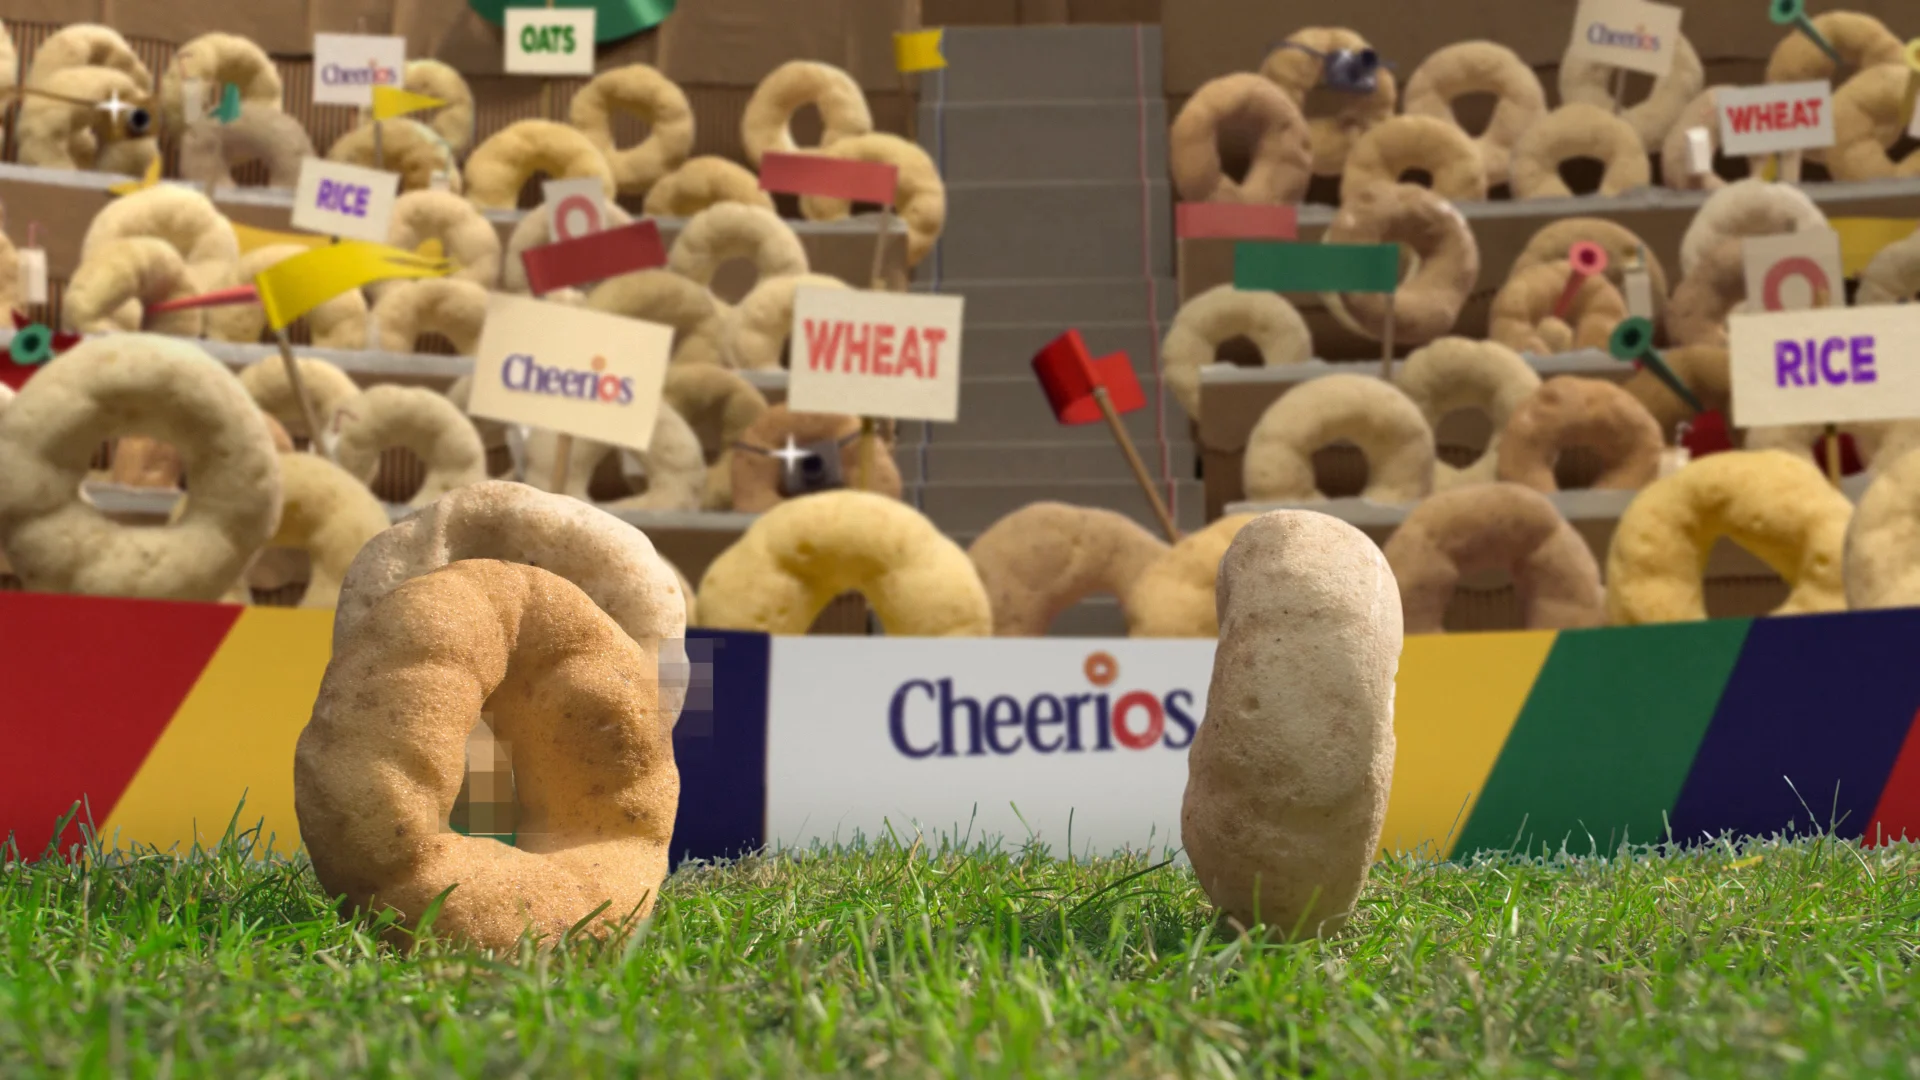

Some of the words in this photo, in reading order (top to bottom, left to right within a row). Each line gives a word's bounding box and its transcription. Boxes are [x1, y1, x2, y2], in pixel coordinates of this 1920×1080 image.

[519, 24, 577, 55] OATS
[1725, 97, 1824, 135] WHEAT
[315, 178, 372, 218] RICE
[803, 317, 948, 381] WHEAT
[1774, 335, 1878, 388] RICE
[501, 353, 635, 406] Cheerios
[888, 650, 1198, 760] Cheerios
